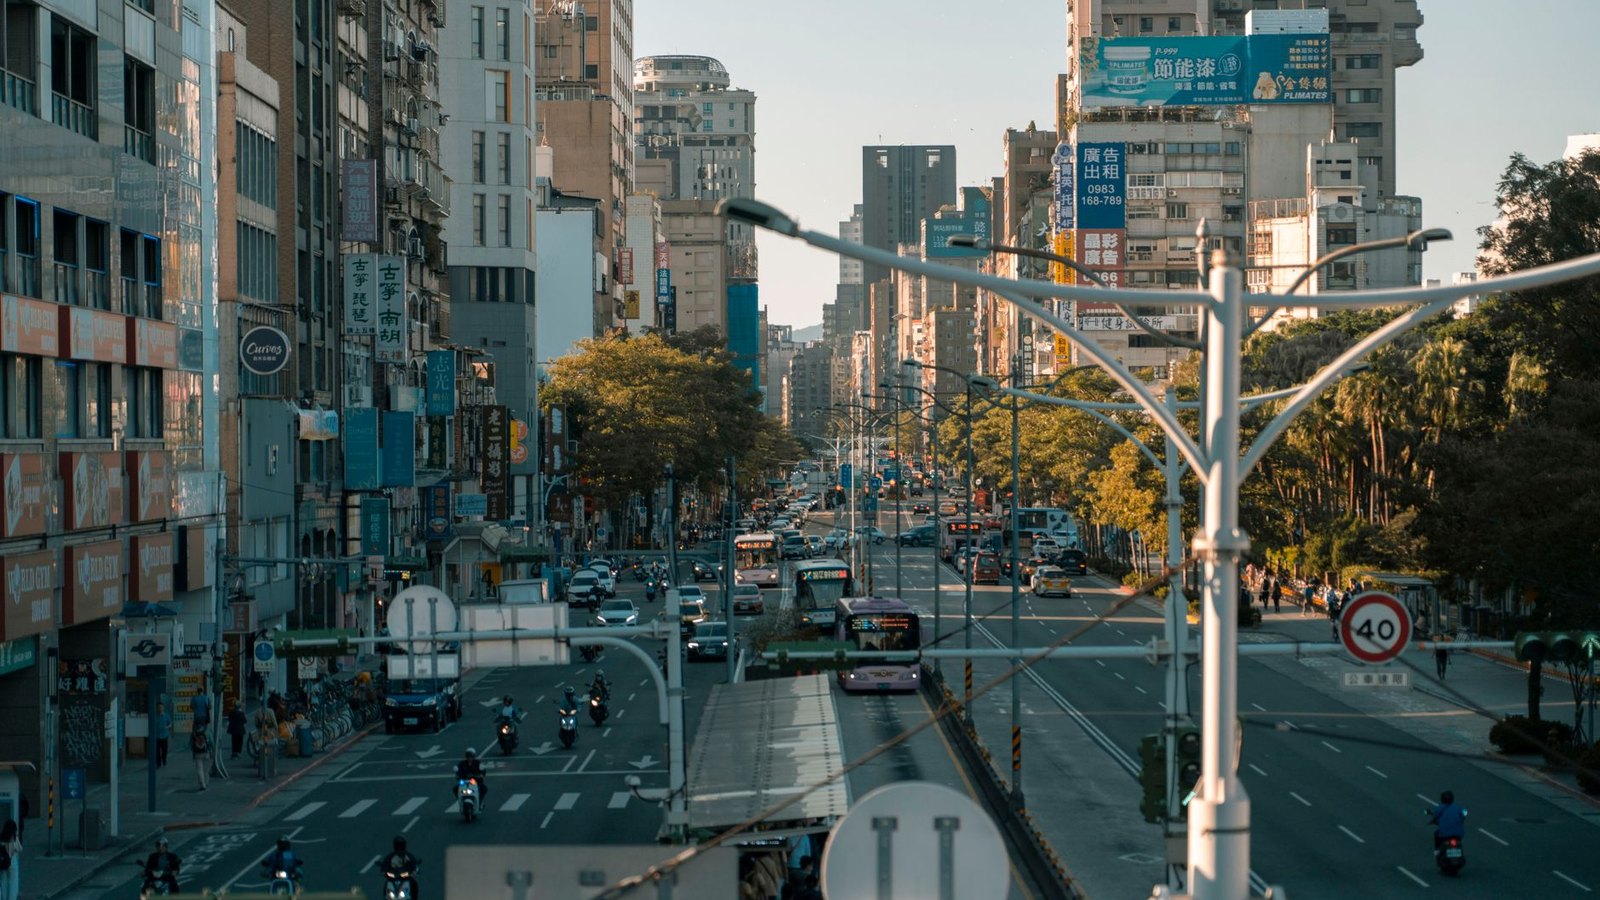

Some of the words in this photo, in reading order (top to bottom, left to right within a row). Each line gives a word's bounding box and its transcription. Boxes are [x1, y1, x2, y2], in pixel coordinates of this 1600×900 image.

[1155, 47, 1178, 56] P-999
[1153, 57, 1216, 79] 節能漆
[1283, 91, 1328, 99] PLIMATES
[1083, 148, 1119, 163] 廣告
[1084, 164, 1119, 179] 出租
[1087, 184, 1115, 194] 0983
[1082, 196, 1122, 205] 168-789
[1061, 219, 1073, 227] 4F
[1084, 250, 1118, 265] 廣告
[379, 263, 402, 344] 古箏·南胡
[246, 342, 282, 355] Curves
[432, 354, 450, 391] 志光
[78, 553, 104, 591] WORLD
[104, 555, 119, 580] GYM
[8, 564, 34, 600] WORLD
[35, 566, 50, 589] GYM
[1357, 618, 1395, 641] 40
